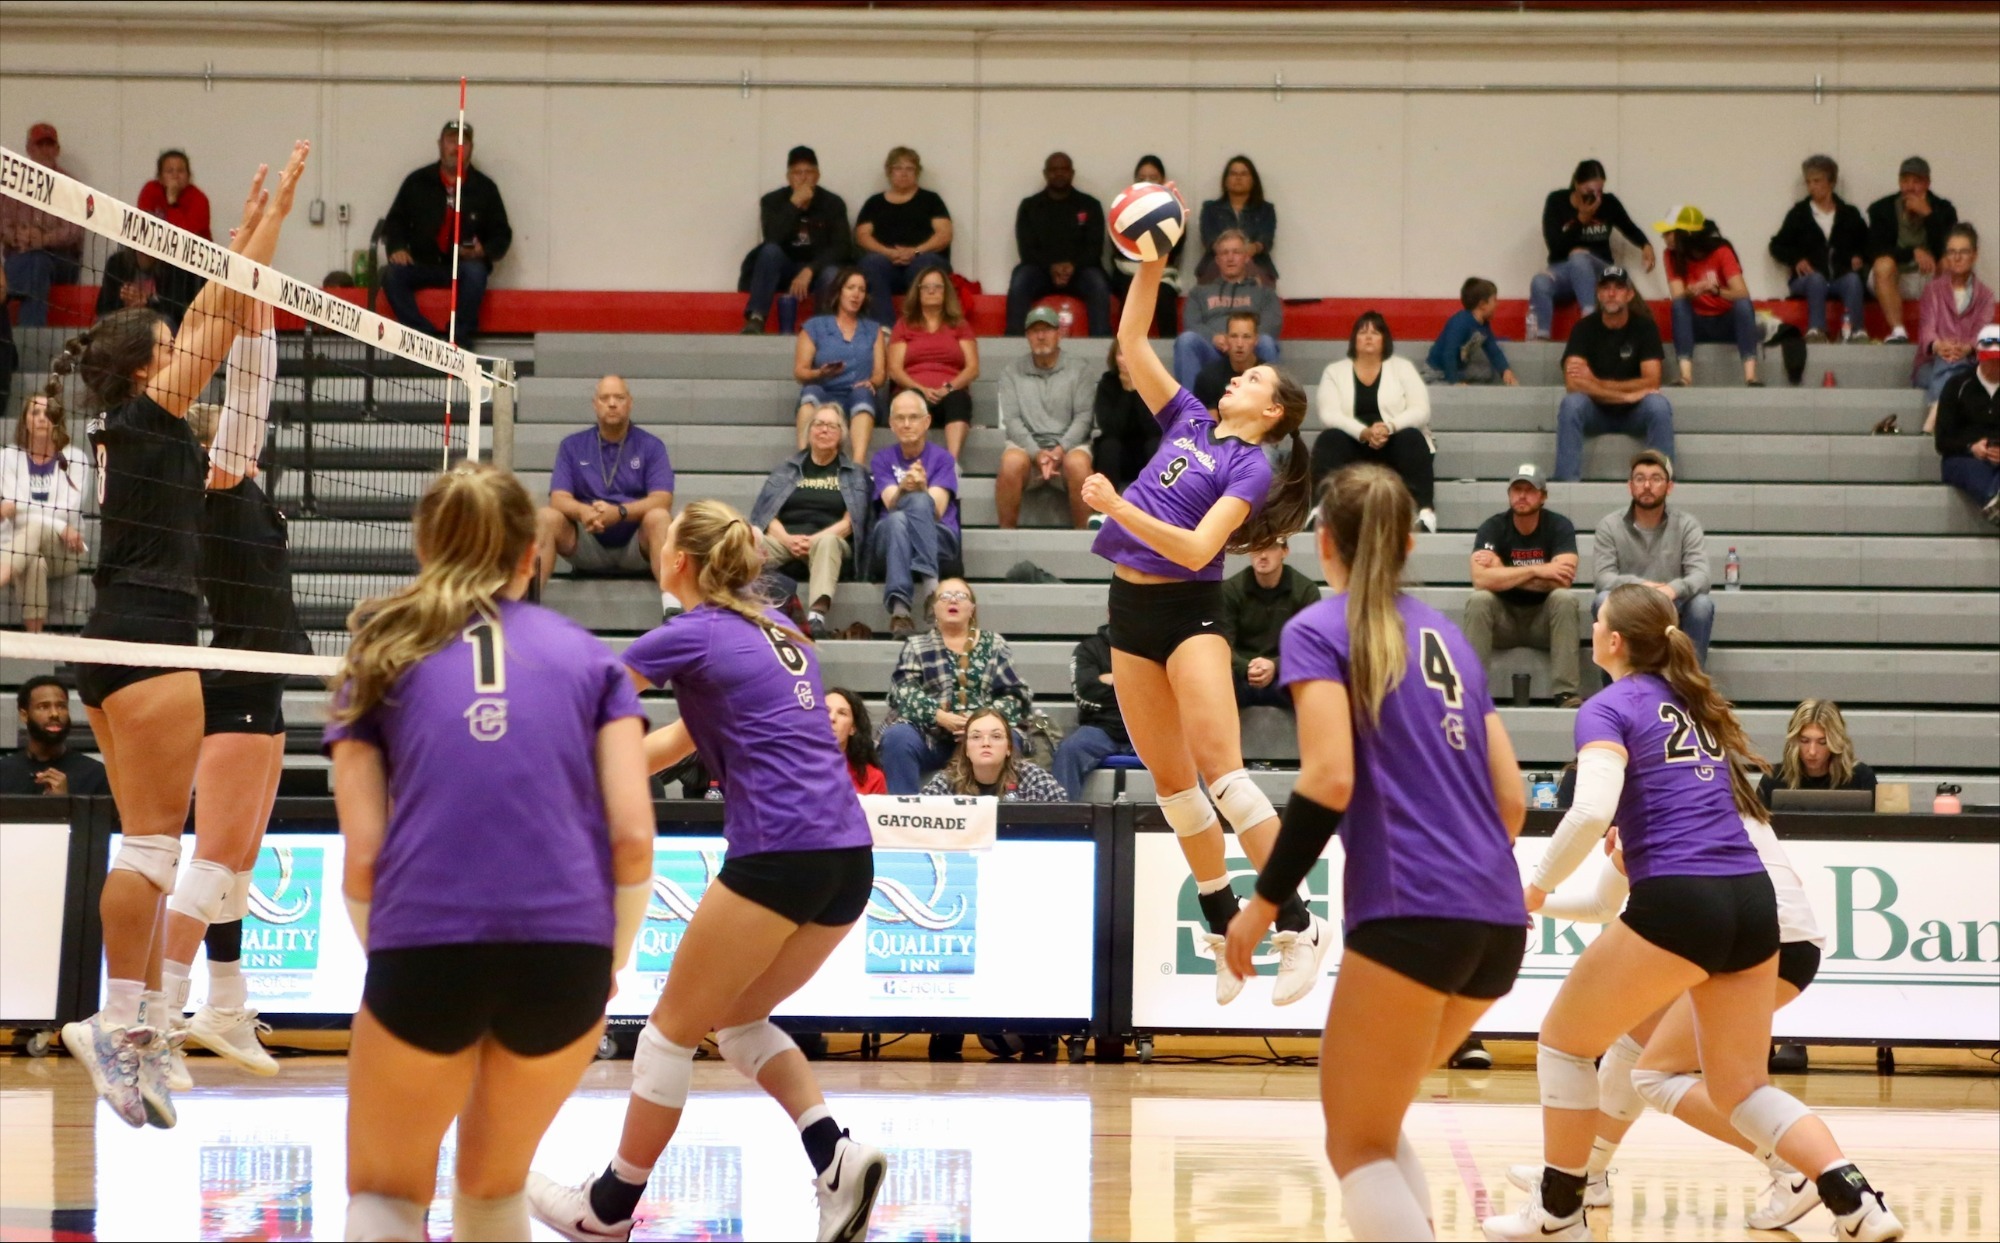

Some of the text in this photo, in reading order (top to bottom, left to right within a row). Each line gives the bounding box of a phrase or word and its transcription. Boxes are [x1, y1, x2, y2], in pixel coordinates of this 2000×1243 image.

[0, 153, 55, 206] ESTERN
[121, 208, 230, 280] MONTANA WESTERN
[279, 278, 362, 333] MONTANA WESTERN
[399, 329, 433, 362] MONTANA
[1159, 455, 1188, 489] 9
[462, 621, 506, 693] 1
[1419, 627, 1464, 710] 4
[878, 814, 967, 830] GATORADE
[241, 928, 316, 951] ALITY
[868, 929, 973, 959] QUALITY
[241, 953, 283, 967] INN
[900, 958, 941, 972] INN
